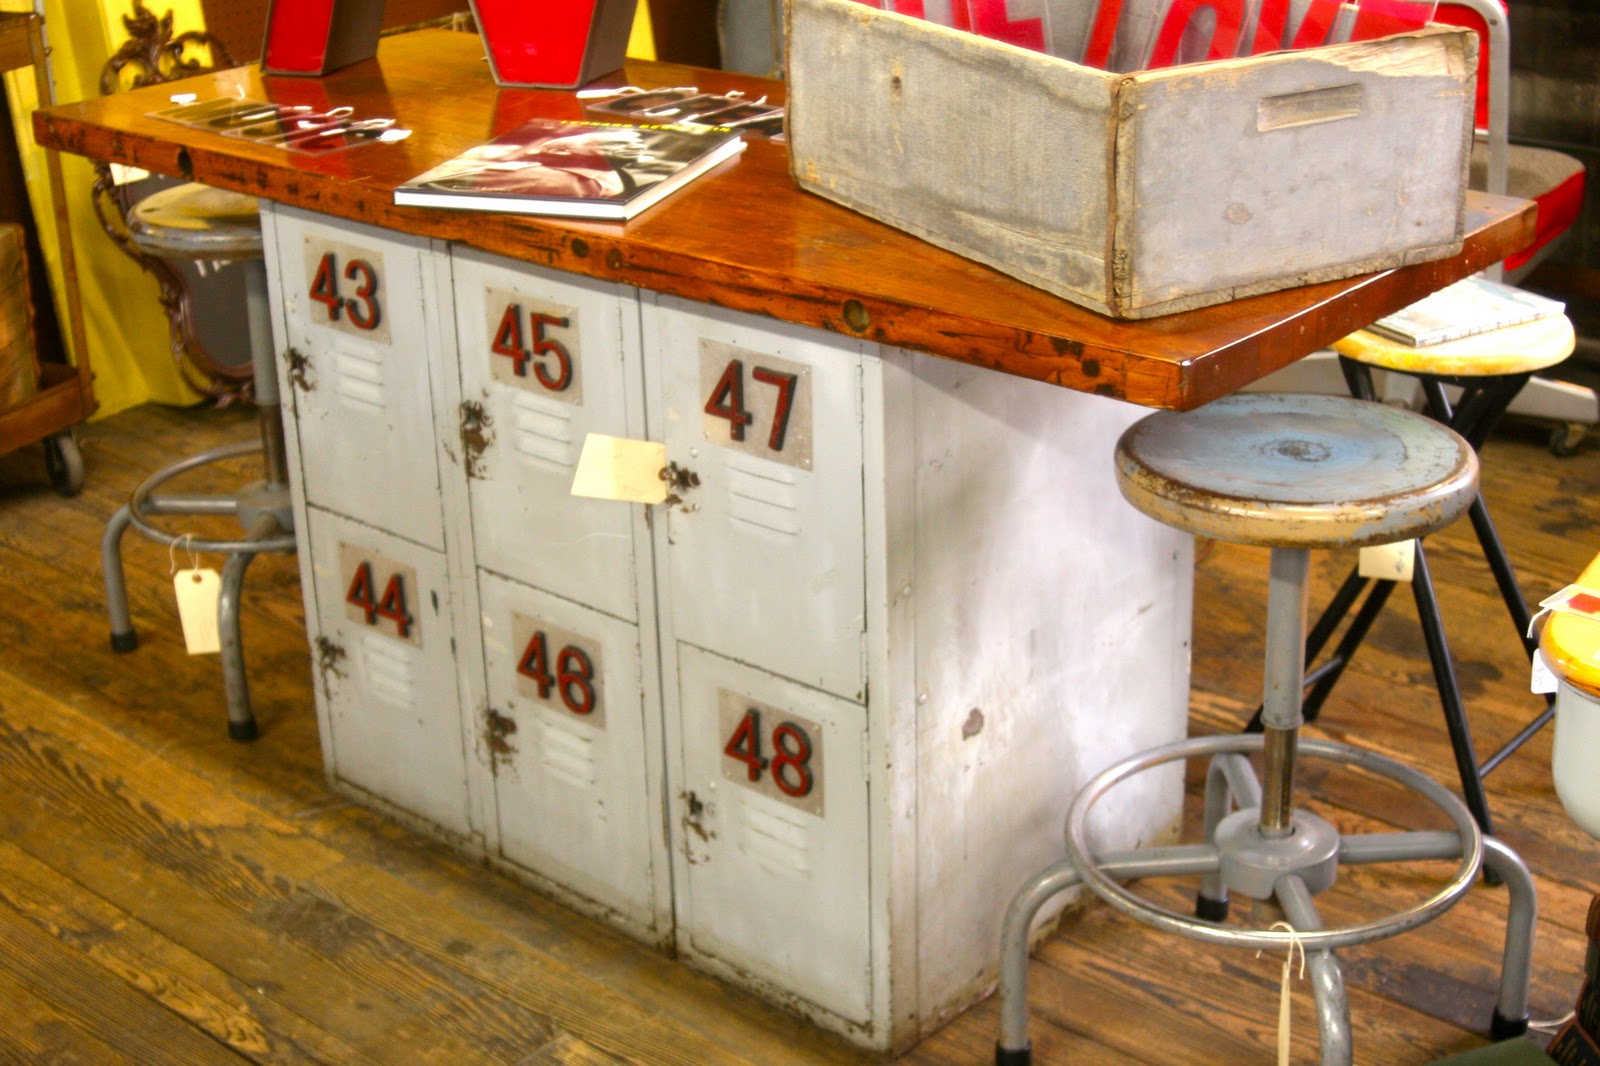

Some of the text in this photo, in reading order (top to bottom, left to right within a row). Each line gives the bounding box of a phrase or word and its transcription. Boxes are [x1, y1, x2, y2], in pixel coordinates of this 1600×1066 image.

[309, 252, 382, 331] 43
[490, 303, 573, 393] 45
[703, 358, 799, 452] 47
[345, 560, 414, 639] 44
[516, 630, 598, 717] 46
[723, 708, 815, 800] 48
